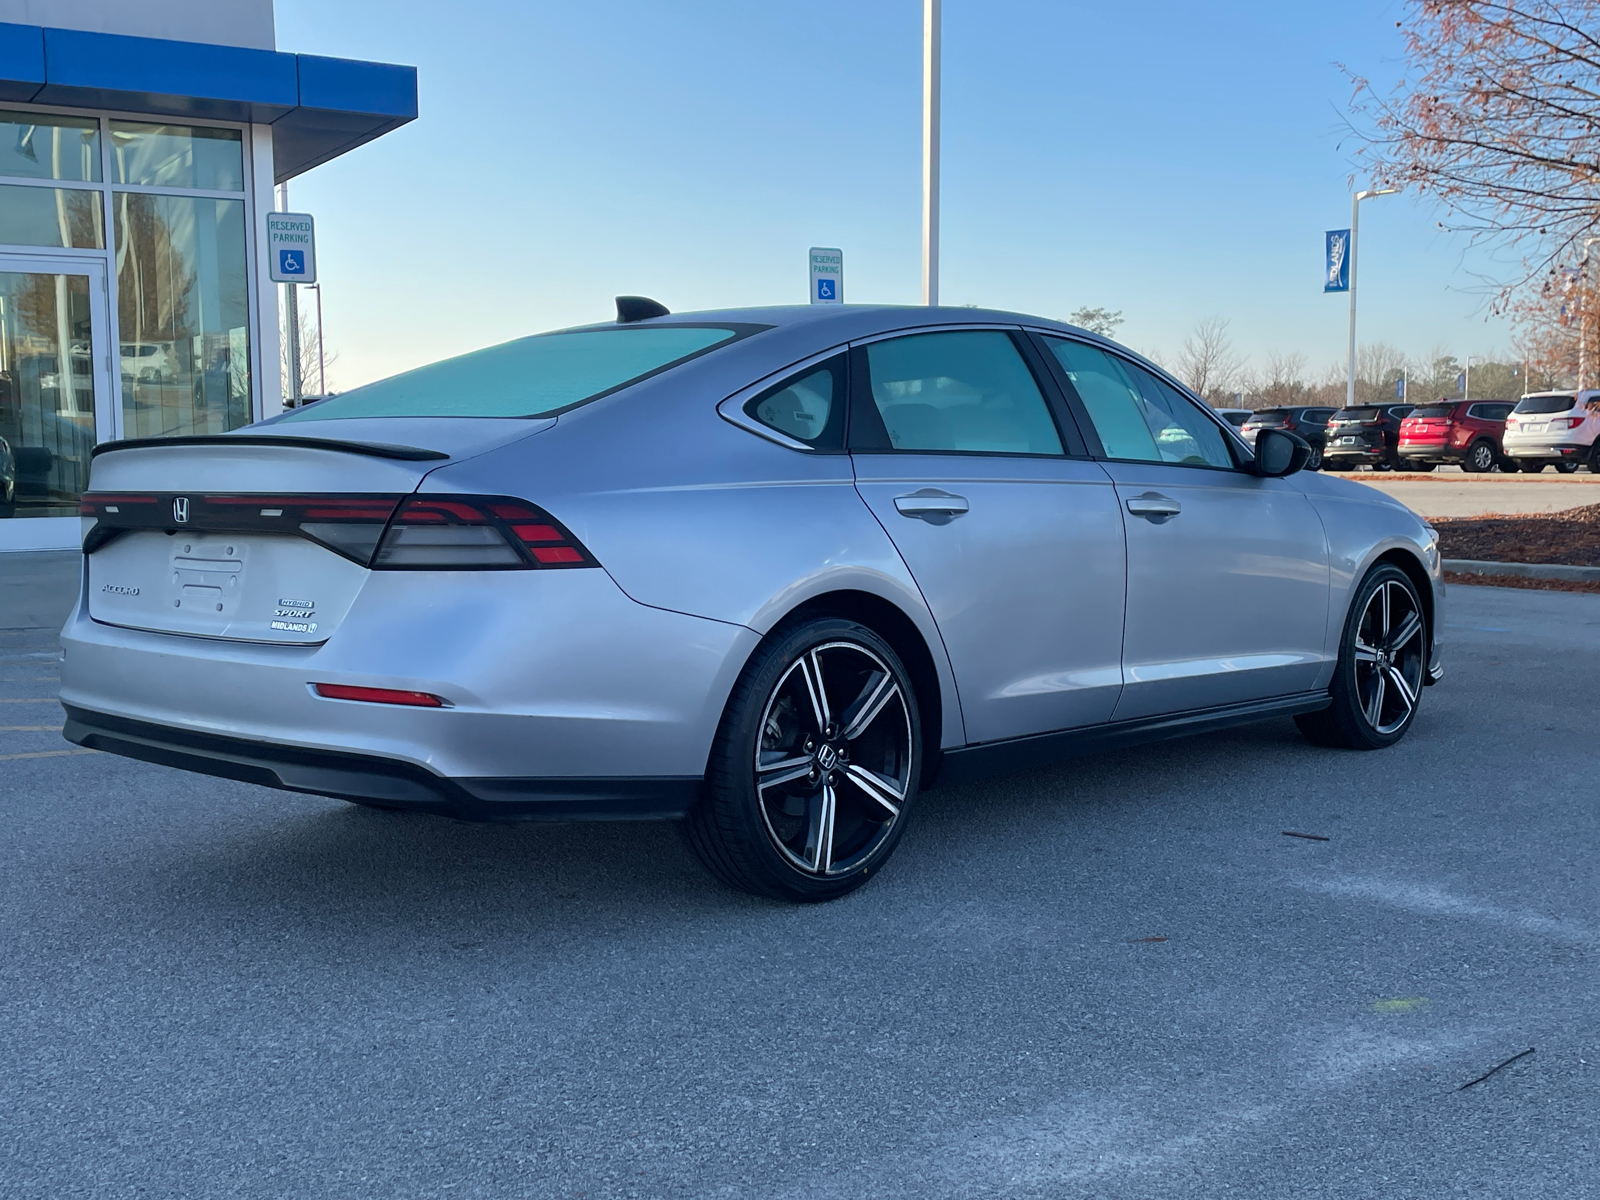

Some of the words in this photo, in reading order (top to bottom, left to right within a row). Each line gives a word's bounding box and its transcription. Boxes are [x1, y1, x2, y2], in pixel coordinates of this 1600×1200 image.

[270, 221, 310, 231] RESERVED
[273, 233, 309, 243] PARKING
[812, 255, 840, 264] RESERVED
[813, 265, 839, 274] PARKING
[102, 584, 140, 596] ACCORD
[273, 609, 314, 618] SPORT
[271, 620, 308, 633] MIDLANDS
